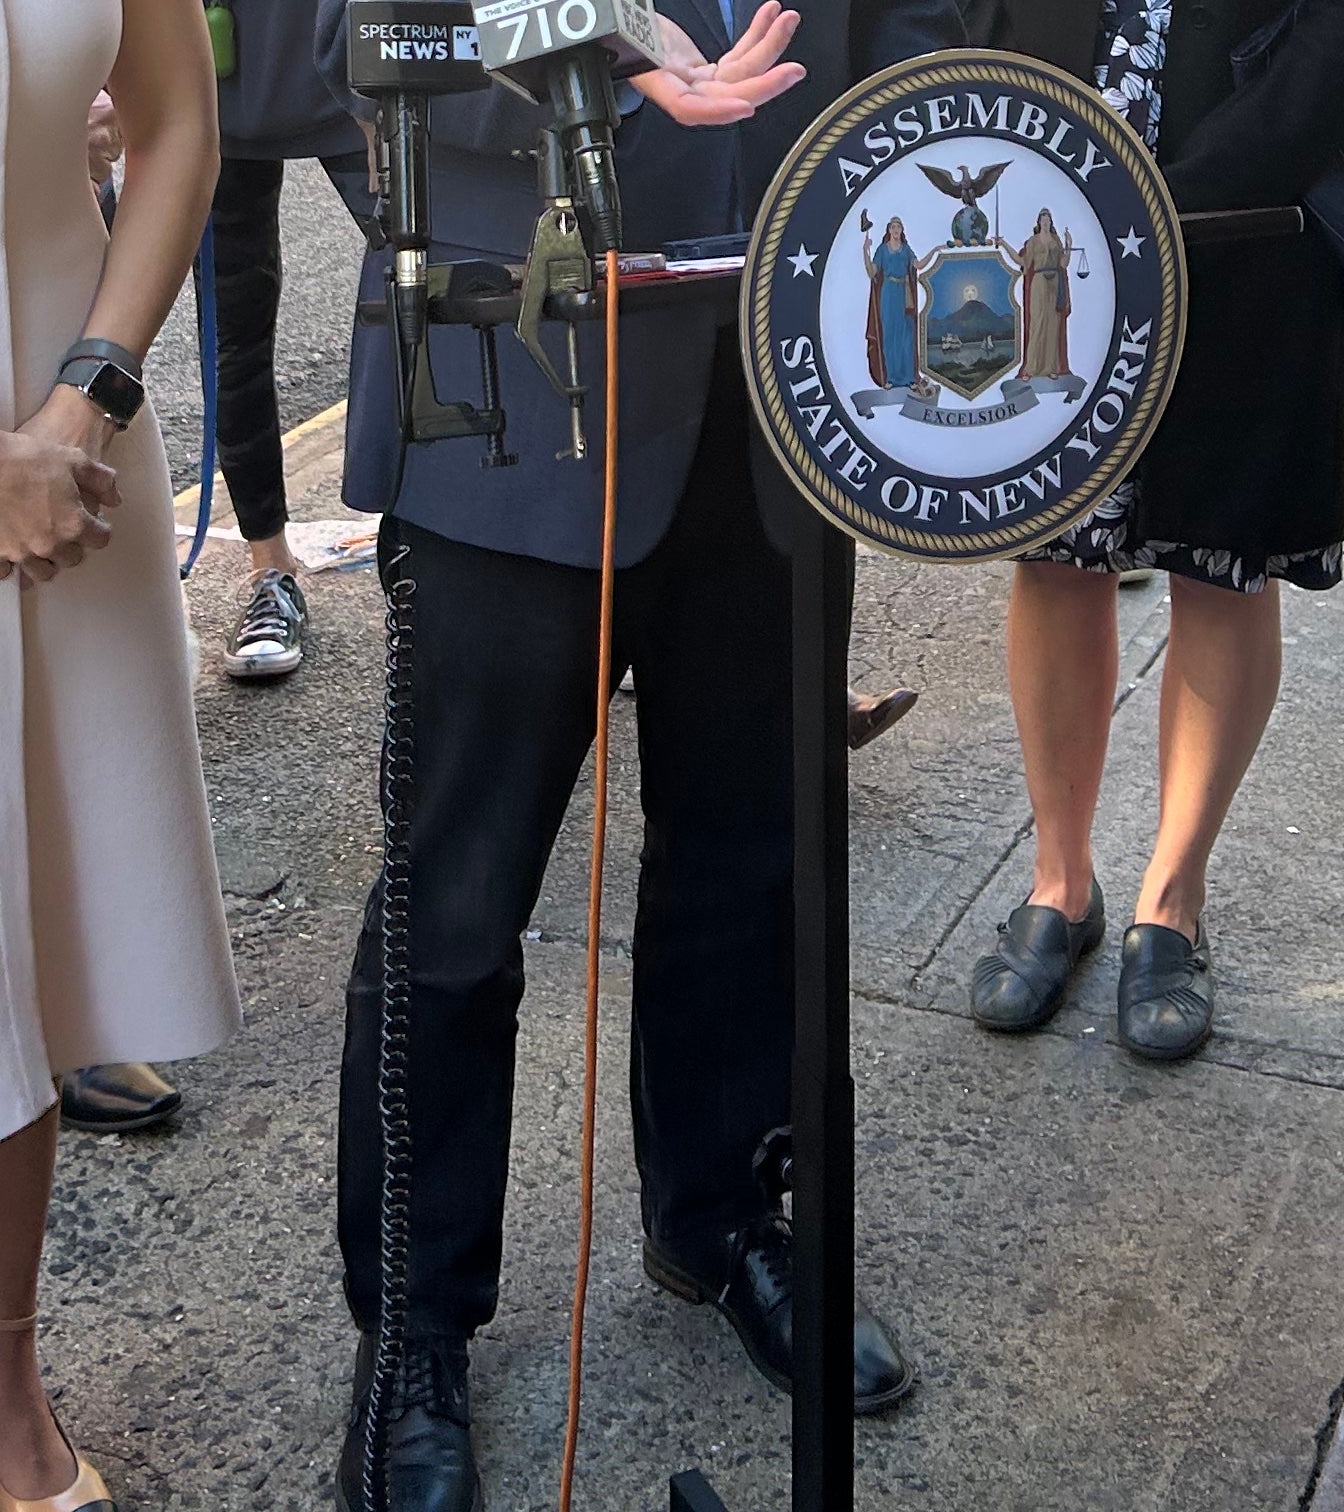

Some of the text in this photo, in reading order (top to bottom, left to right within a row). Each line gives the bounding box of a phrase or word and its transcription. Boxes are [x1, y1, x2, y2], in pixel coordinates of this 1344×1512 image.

[485, 7, 502, 18] THE
[359, 24, 447, 39] SPECTRUM
[456, 30, 472, 39] NY
[380, 41, 449, 61] NEWS
[471, 43, 479, 56] 1
[837, 92, 1114, 197] ASSEMBLY
[780, 314, 1154, 525] STATE OF NEW YORK
[922, 404, 1020, 424] EXCELSIOR
